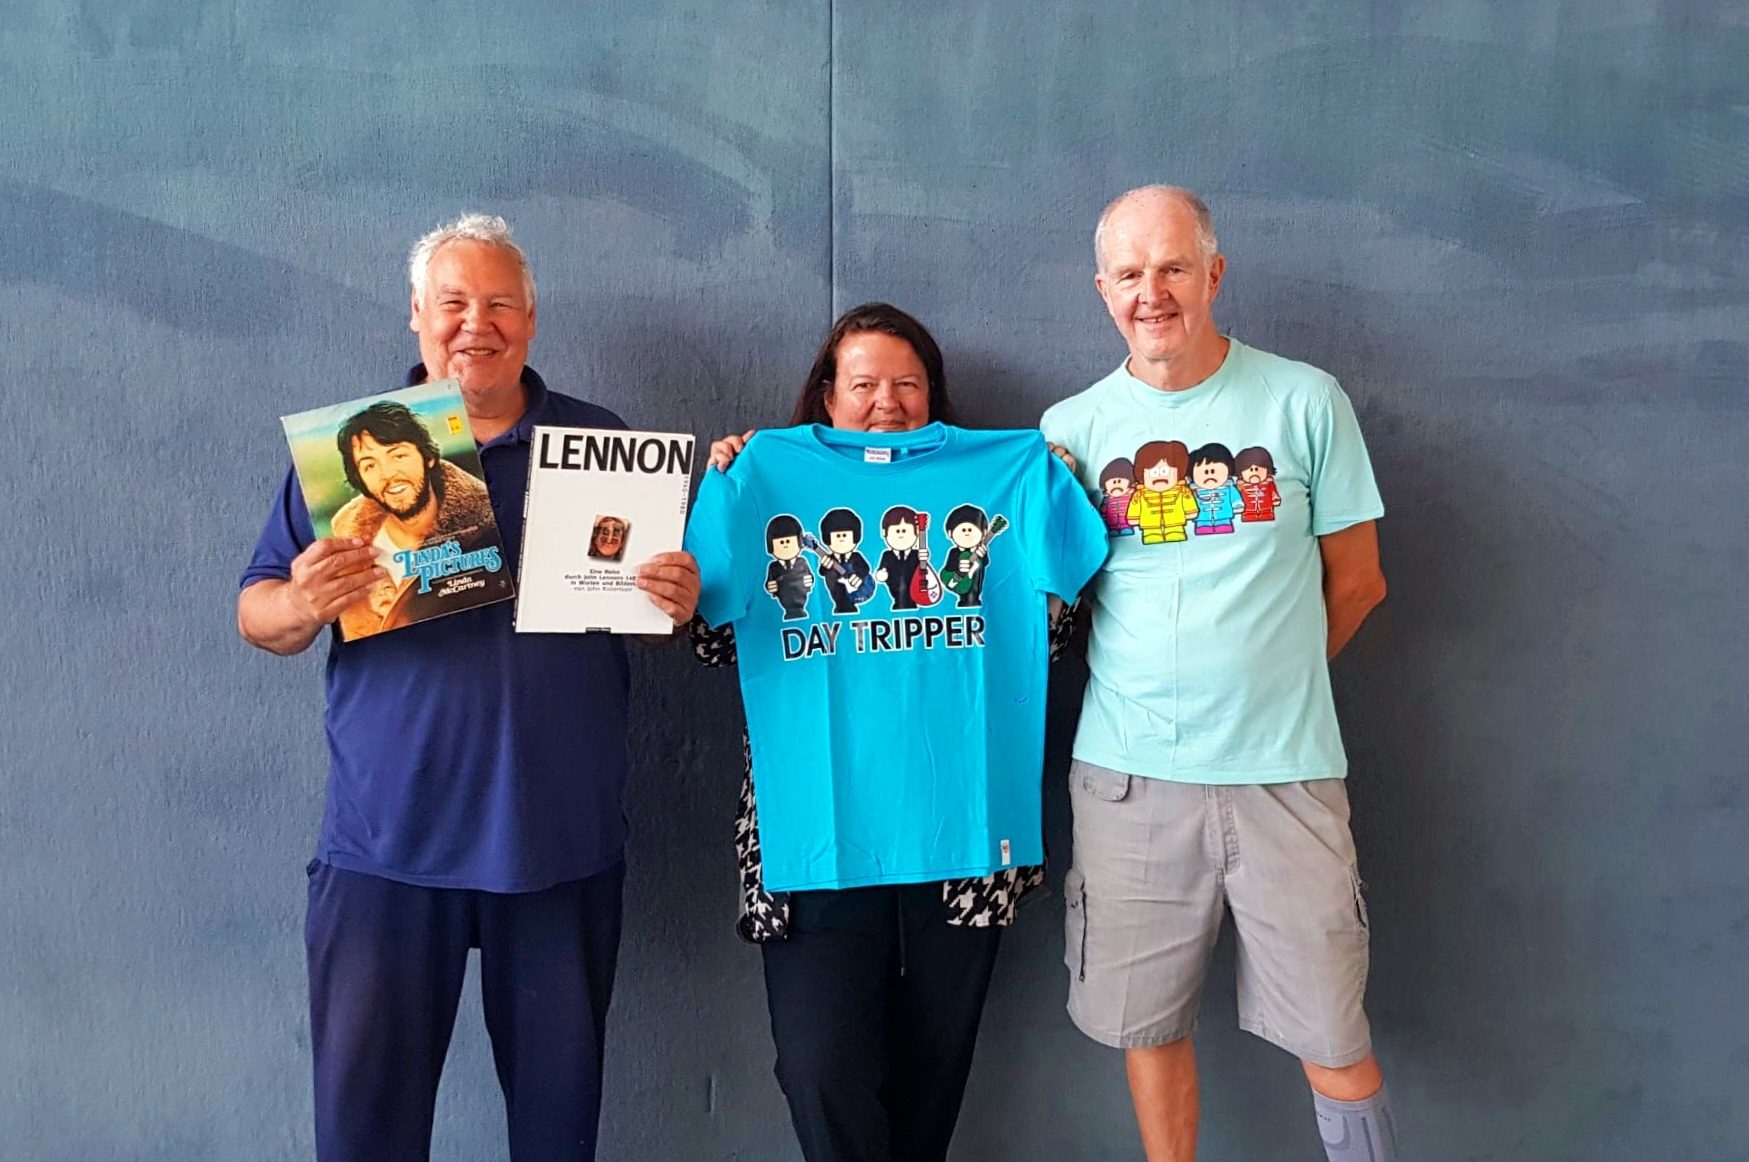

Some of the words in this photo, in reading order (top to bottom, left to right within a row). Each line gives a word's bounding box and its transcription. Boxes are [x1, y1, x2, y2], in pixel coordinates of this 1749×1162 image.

[539, 433, 694, 475] LENNON
[418, 546, 502, 595] PICTURES
[438, 579, 486, 597] McCartney
[447, 576, 472, 588] Linda
[780, 620, 842, 662] DAY
[851, 614, 986, 653] TRIPPER
